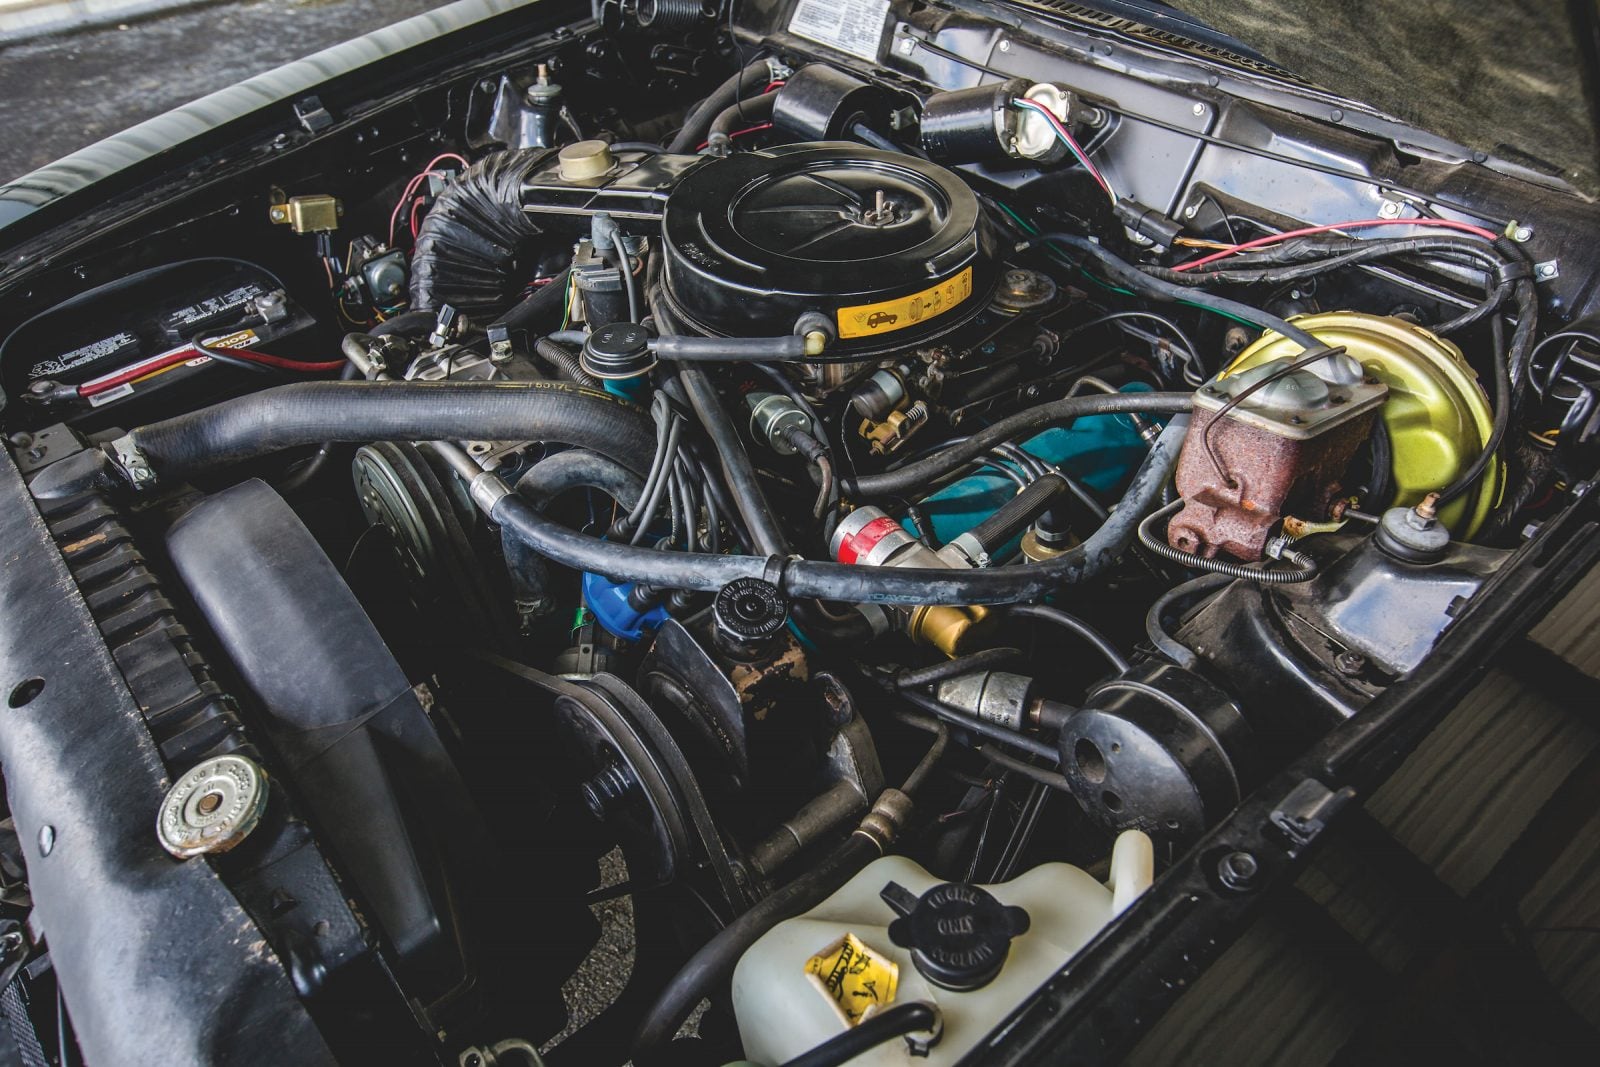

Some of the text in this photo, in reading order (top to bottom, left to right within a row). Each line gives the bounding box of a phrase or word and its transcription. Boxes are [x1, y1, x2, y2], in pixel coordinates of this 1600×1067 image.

[215, 333, 249, 348] GOLD
[874, 593, 921, 603] DAYCO
[928, 887, 980, 909] ENGINE
[937, 914, 974, 935] ONLY
[932, 942, 994, 966] COOLANT
